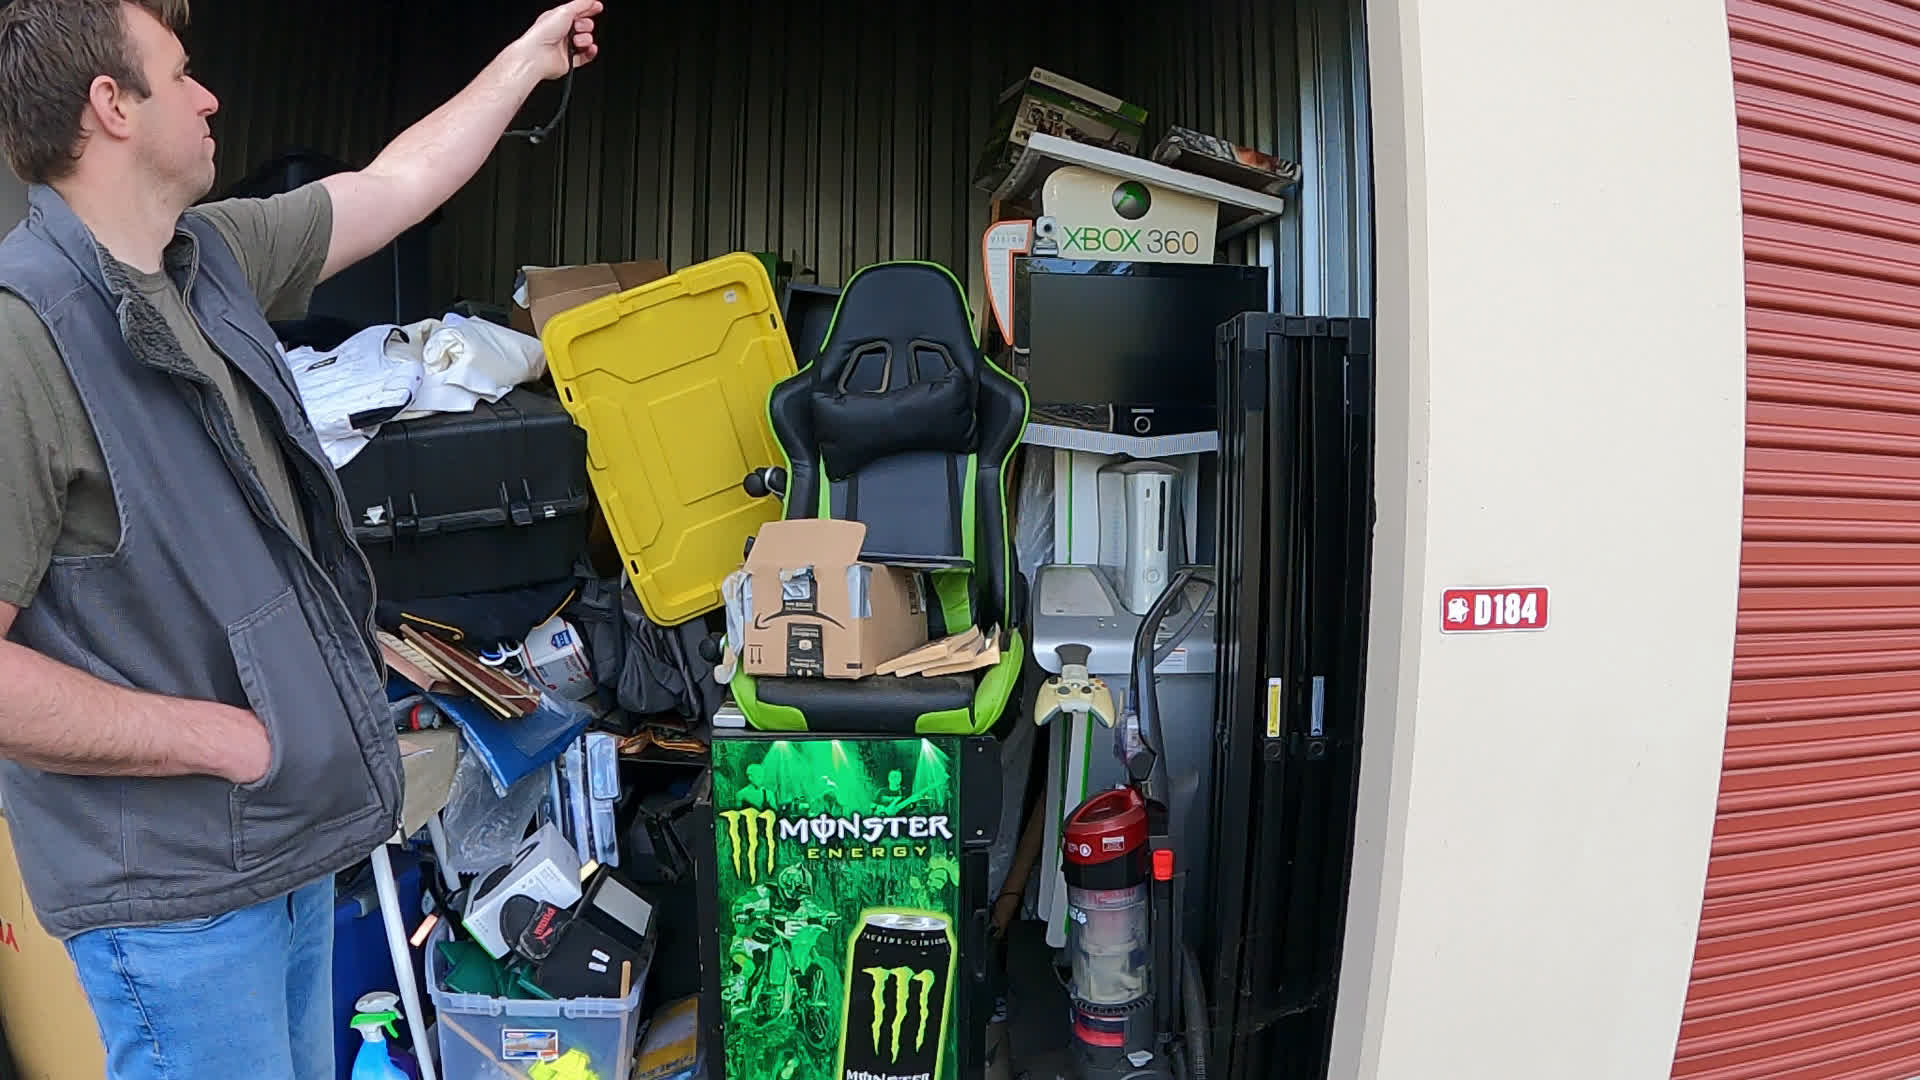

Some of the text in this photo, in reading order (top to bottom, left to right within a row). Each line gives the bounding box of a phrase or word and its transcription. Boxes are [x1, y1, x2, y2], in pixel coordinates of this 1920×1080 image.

[1063, 226, 1199, 255] XBOX 360
[1474, 592, 1538, 626] D184
[778, 813, 953, 845] MONSTER
[807, 846, 927, 859] ENERGY
